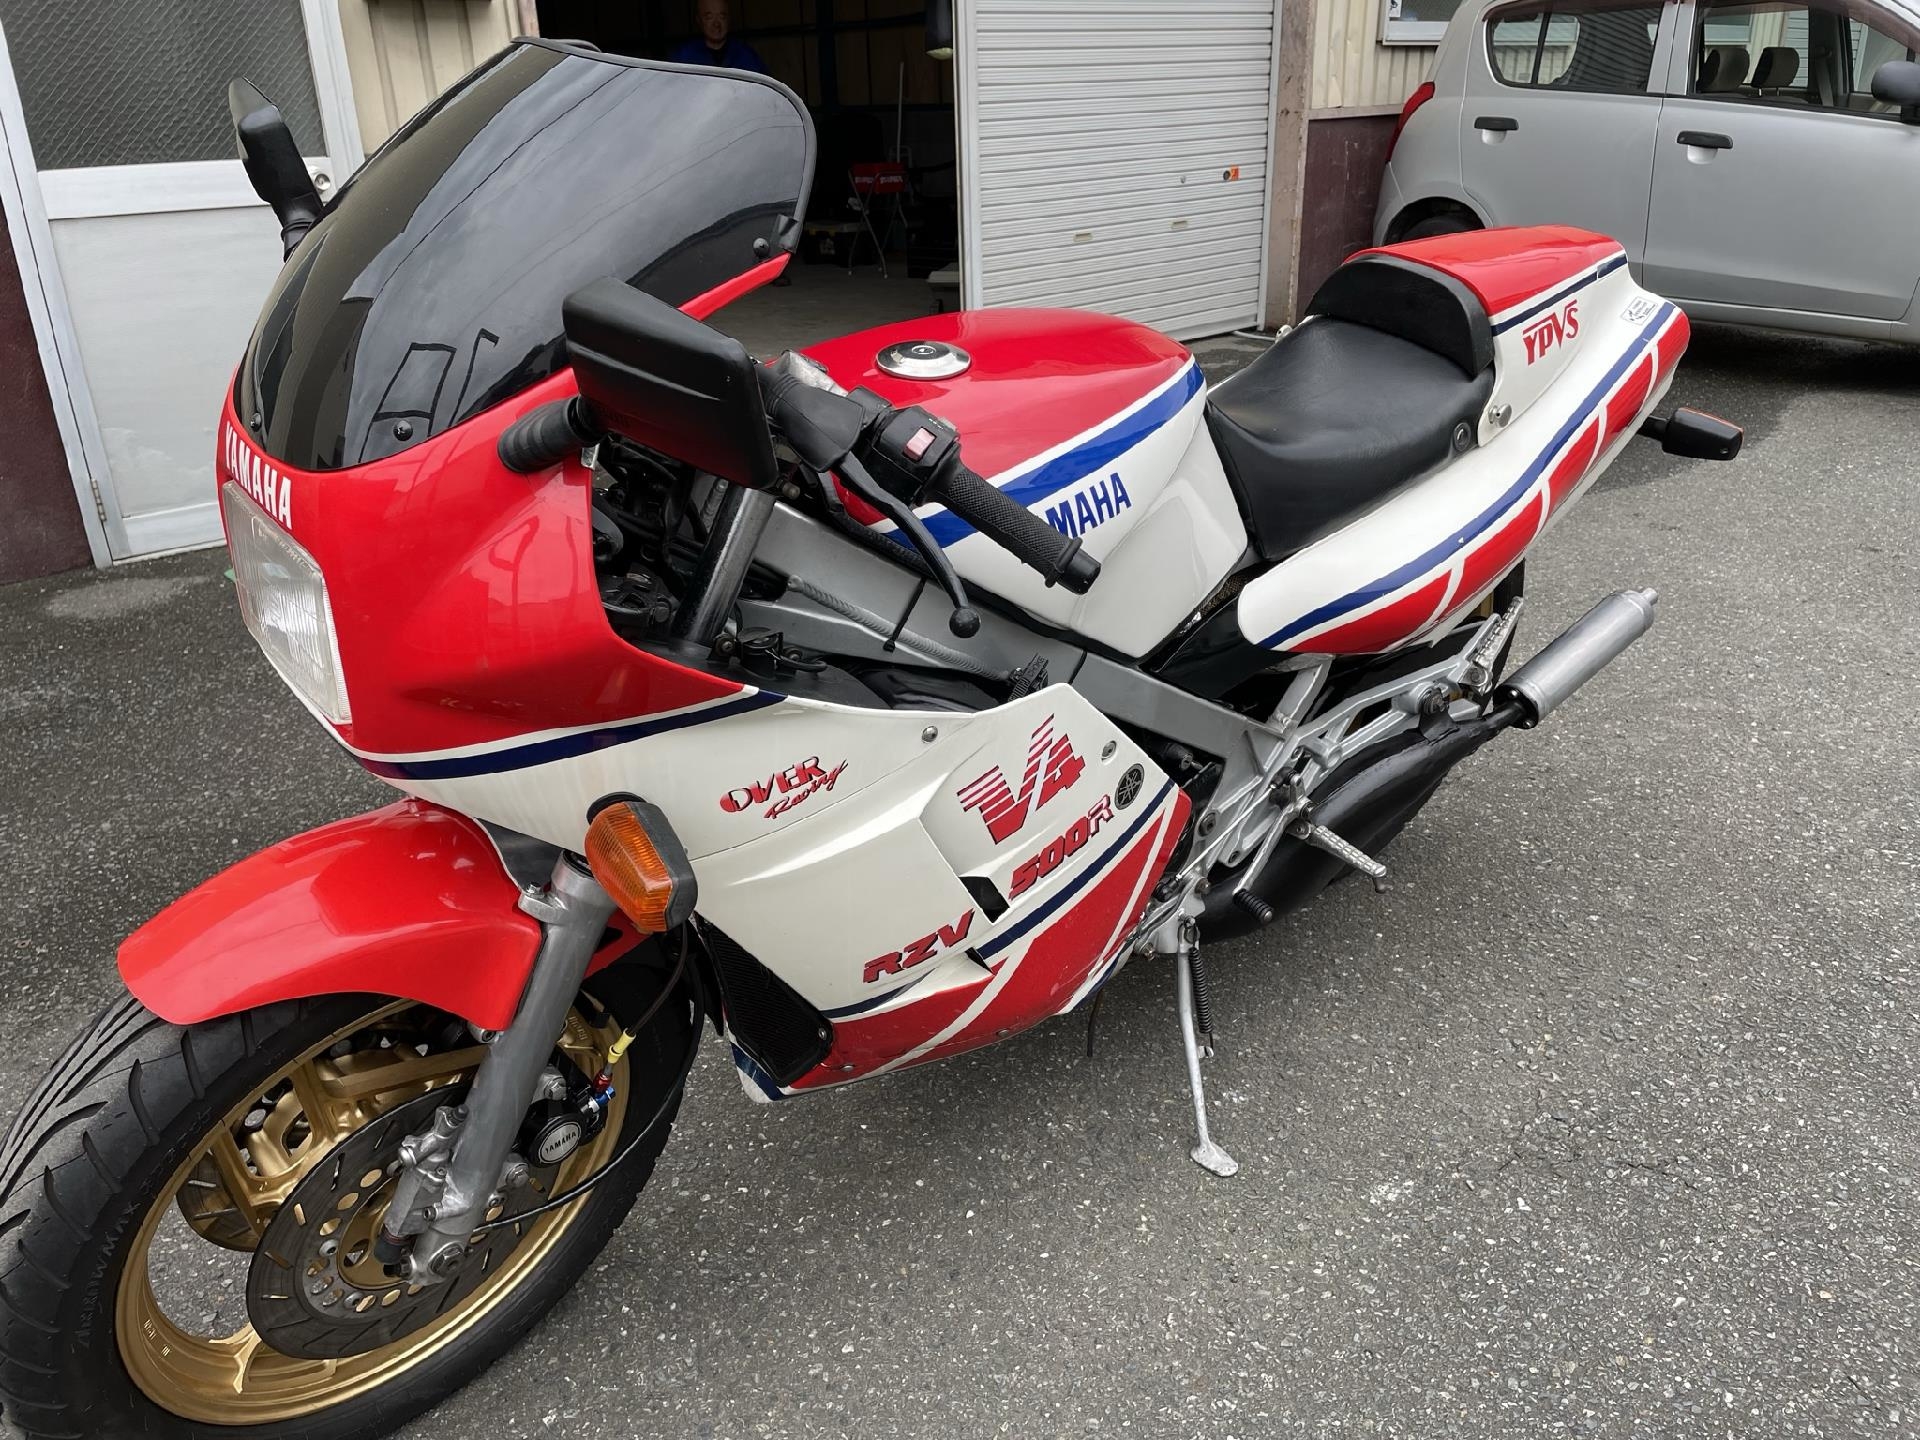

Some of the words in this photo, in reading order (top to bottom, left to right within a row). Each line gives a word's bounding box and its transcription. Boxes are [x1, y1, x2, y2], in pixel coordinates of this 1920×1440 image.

[1522, 299, 1579, 367] YPVS
[225, 420, 293, 531] YAMAHA
[1044, 471, 1133, 540] MAHA
[719, 755, 827, 813] OVER
[763, 758, 849, 820] Racing
[956, 713, 1086, 846] V4
[1008, 794, 1115, 901] 500R
[862, 907, 976, 984] RZV
[545, 1131, 577, 1155] YAMAHA
